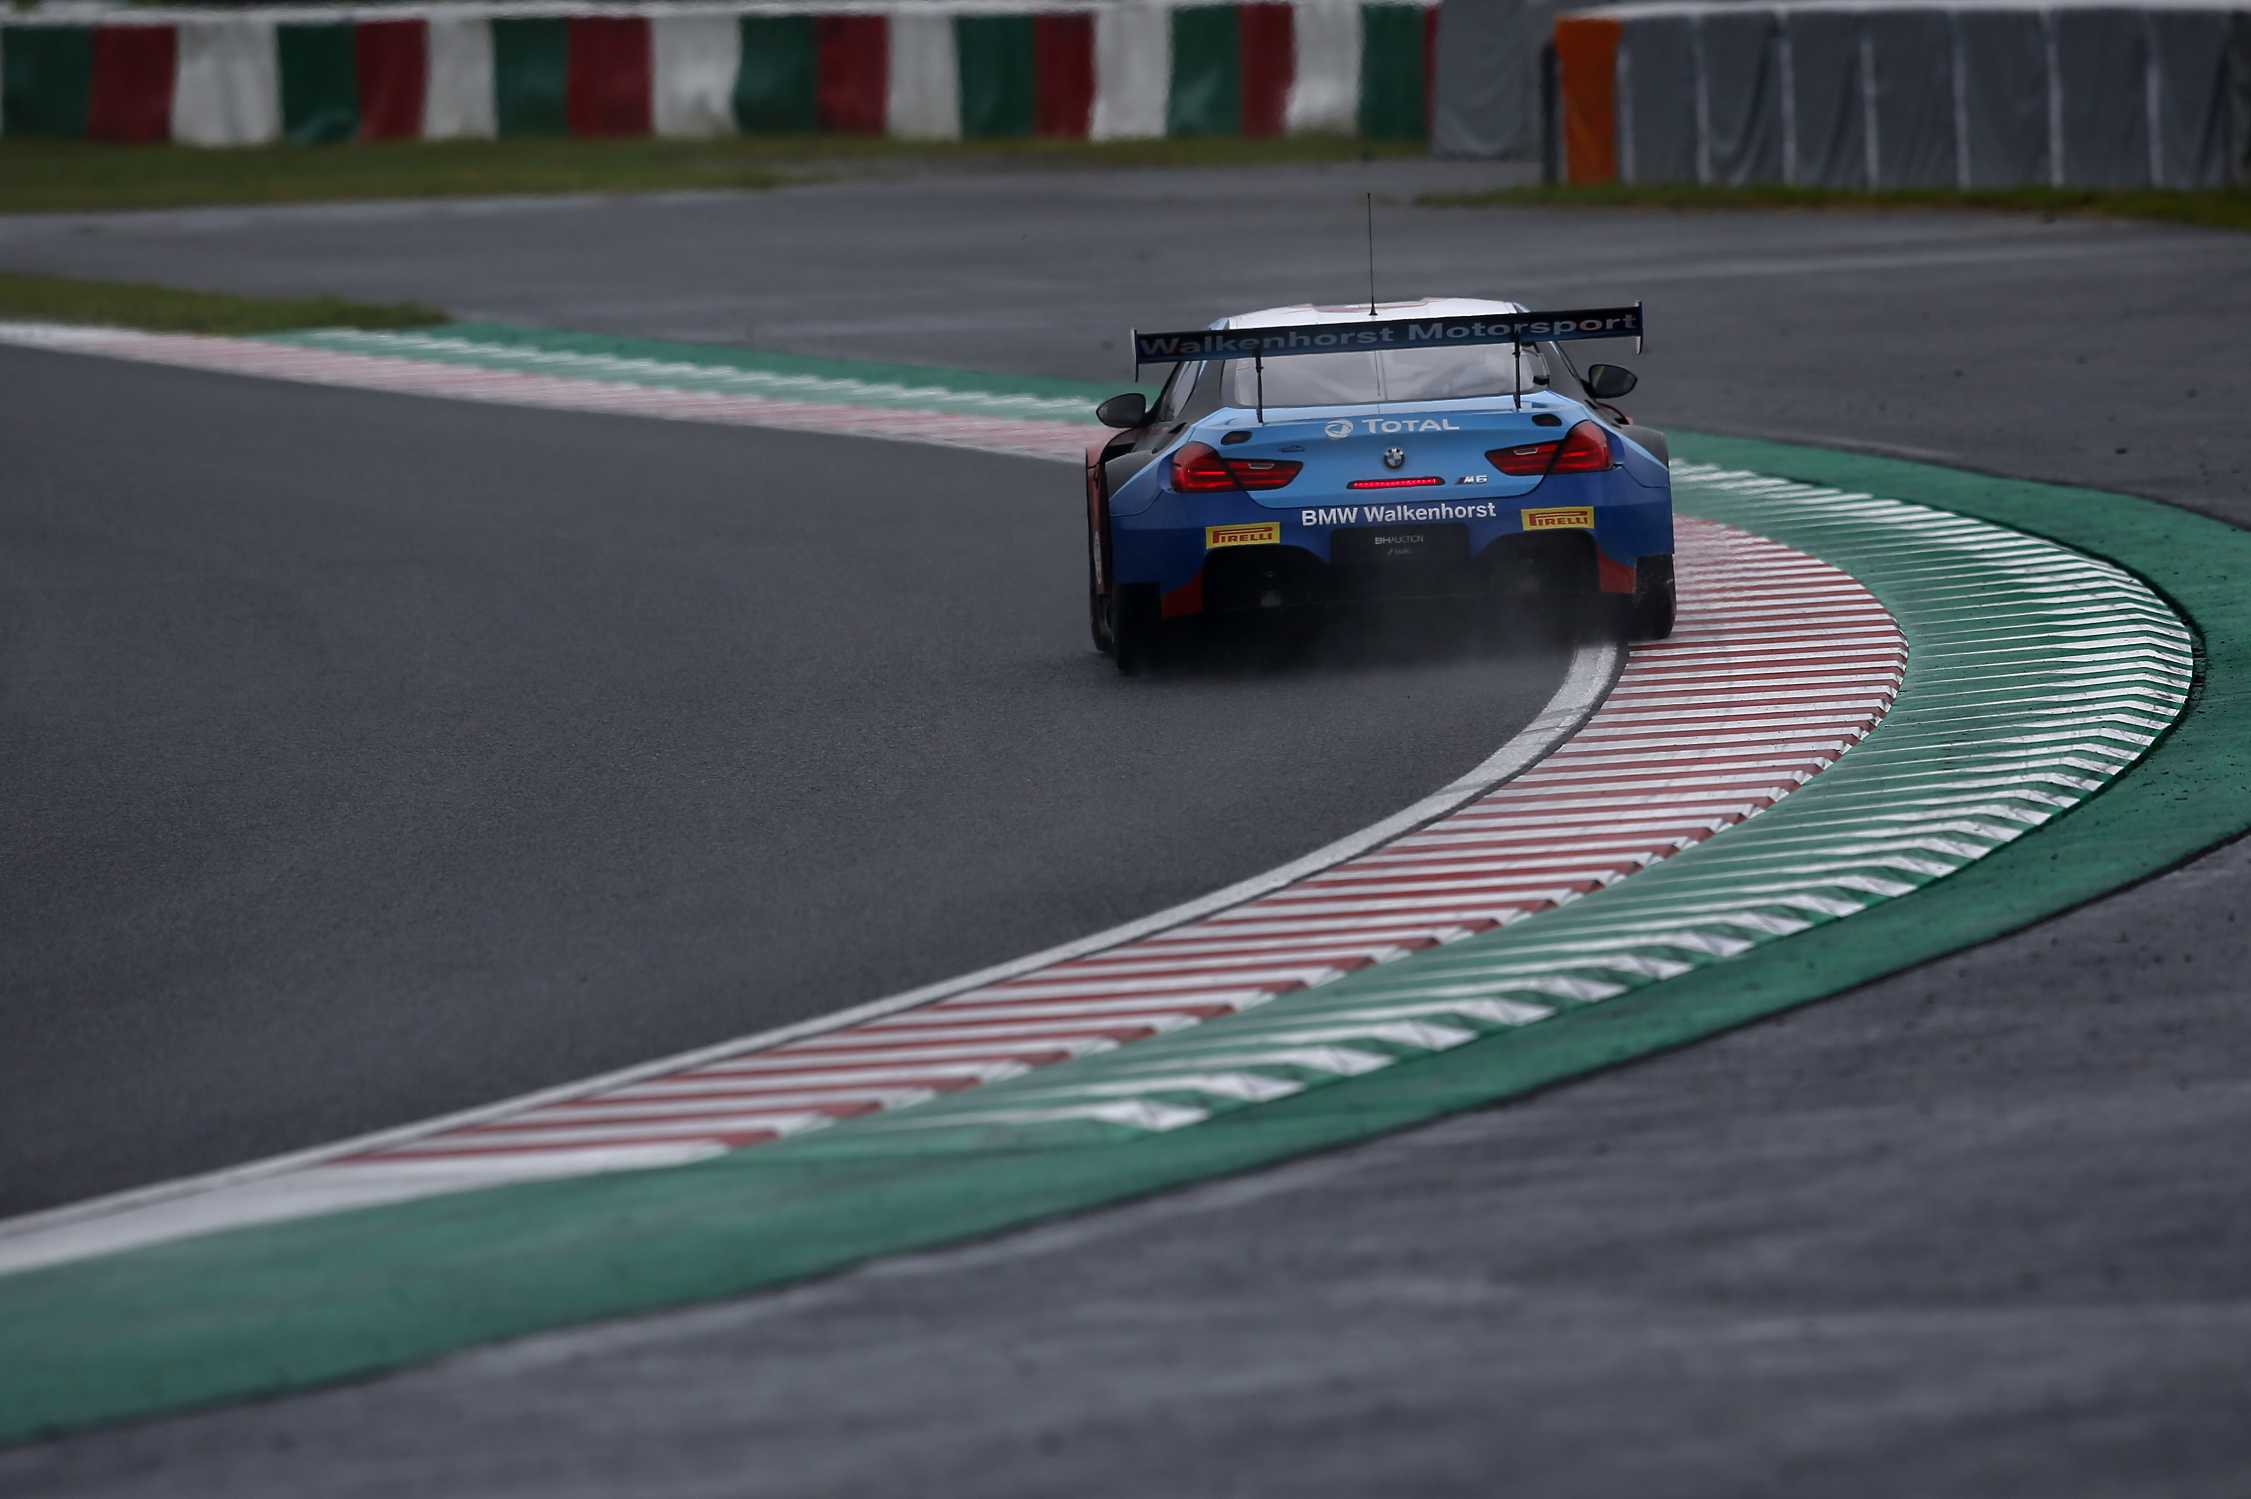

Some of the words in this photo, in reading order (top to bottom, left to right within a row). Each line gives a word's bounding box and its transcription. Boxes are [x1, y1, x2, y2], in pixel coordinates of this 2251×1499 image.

[1140, 327, 1393, 354] Walkenhorst
[1408, 314, 1637, 341] Motorsport
[1302, 507, 1358, 526] BMW
[1363, 502, 1497, 522] Walkenhorst
[1529, 511, 1588, 526] PIRELLI
[1213, 527, 1273, 544] PIRELLI
